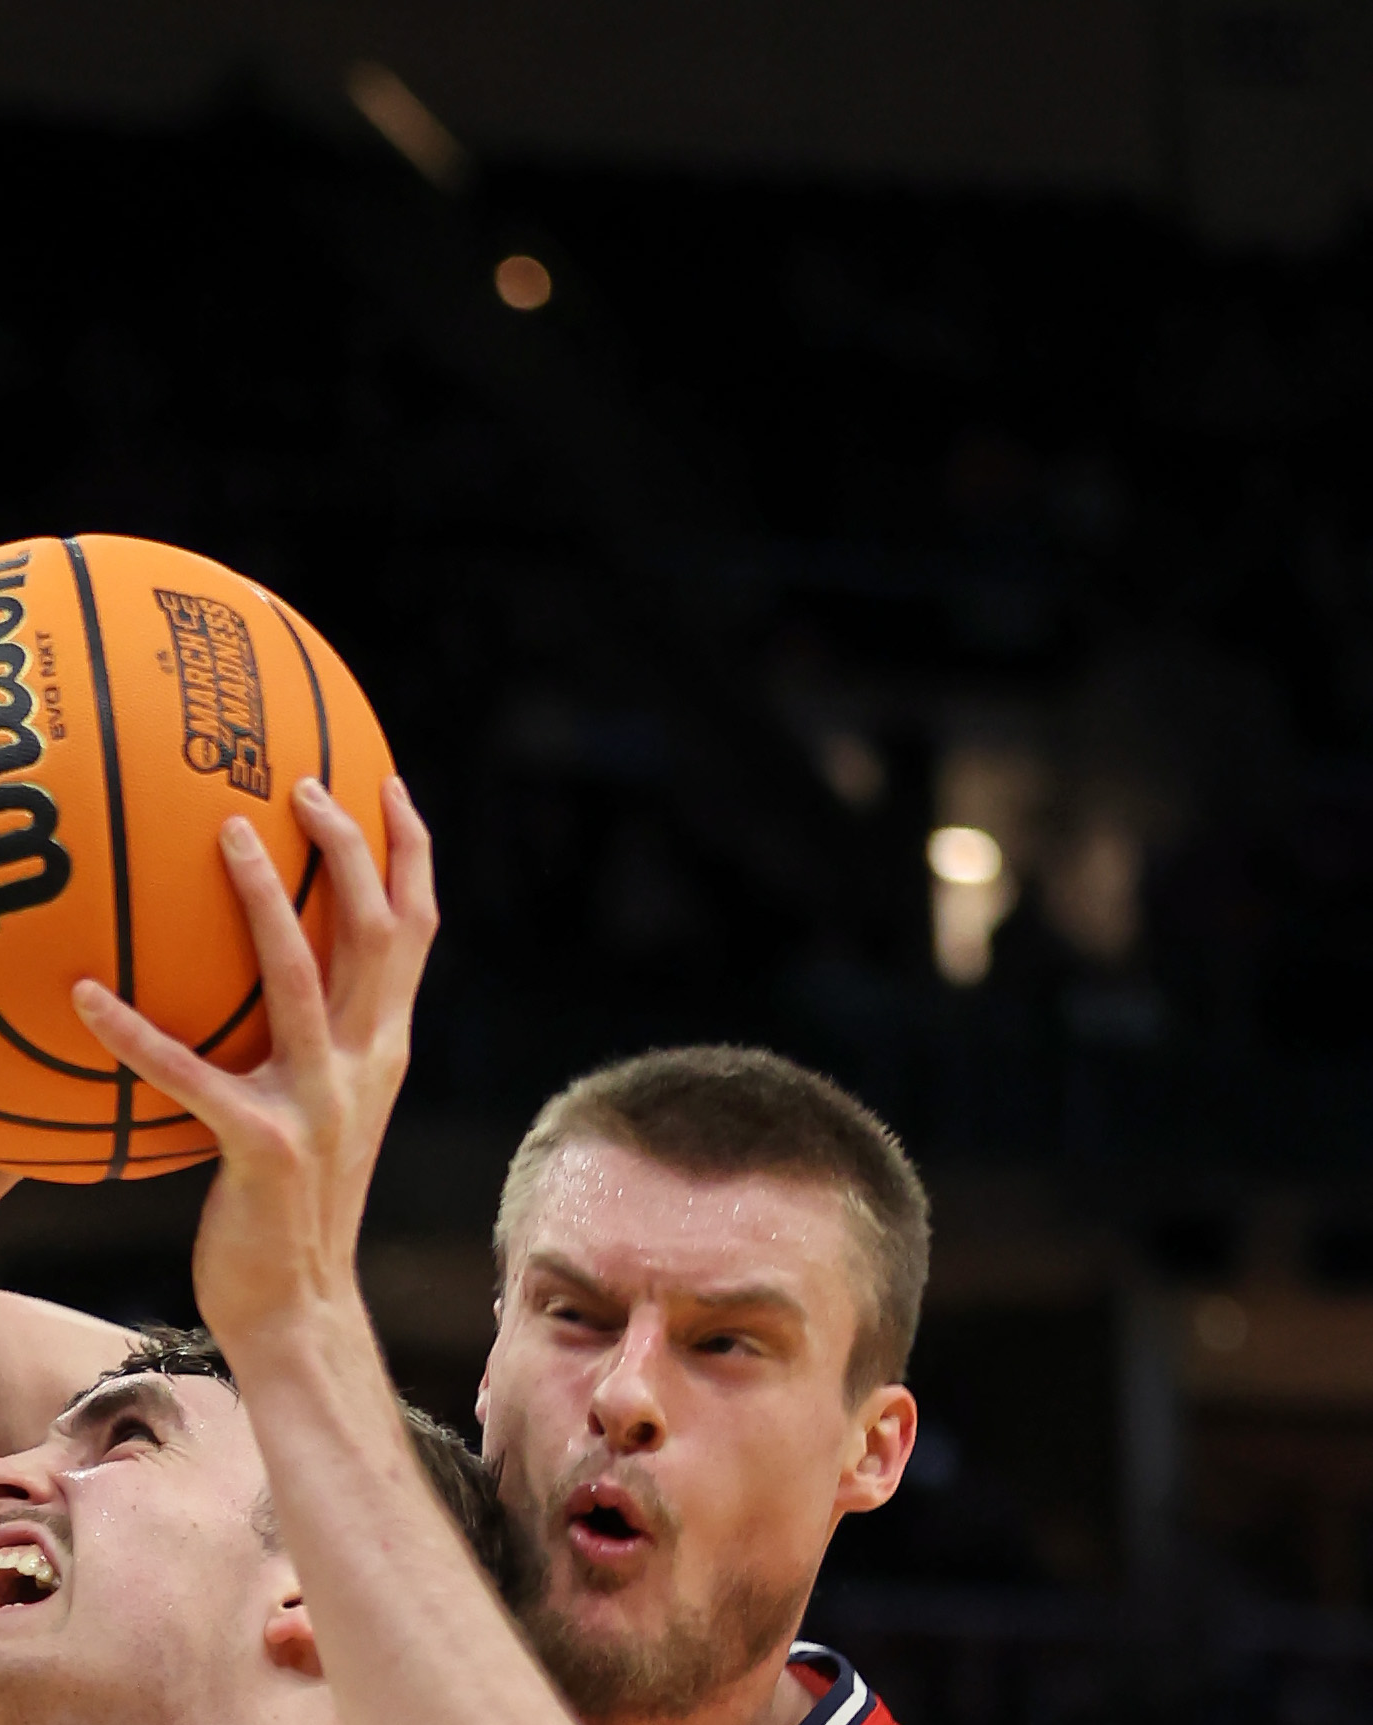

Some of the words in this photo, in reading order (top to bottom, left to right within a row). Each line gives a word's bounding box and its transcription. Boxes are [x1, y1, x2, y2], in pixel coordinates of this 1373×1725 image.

[35, 630, 58, 678] NXT
[176, 631, 220, 737] MARCH
[200, 599, 252, 731] MADNESS
[43, 685, 67, 740] EVO
